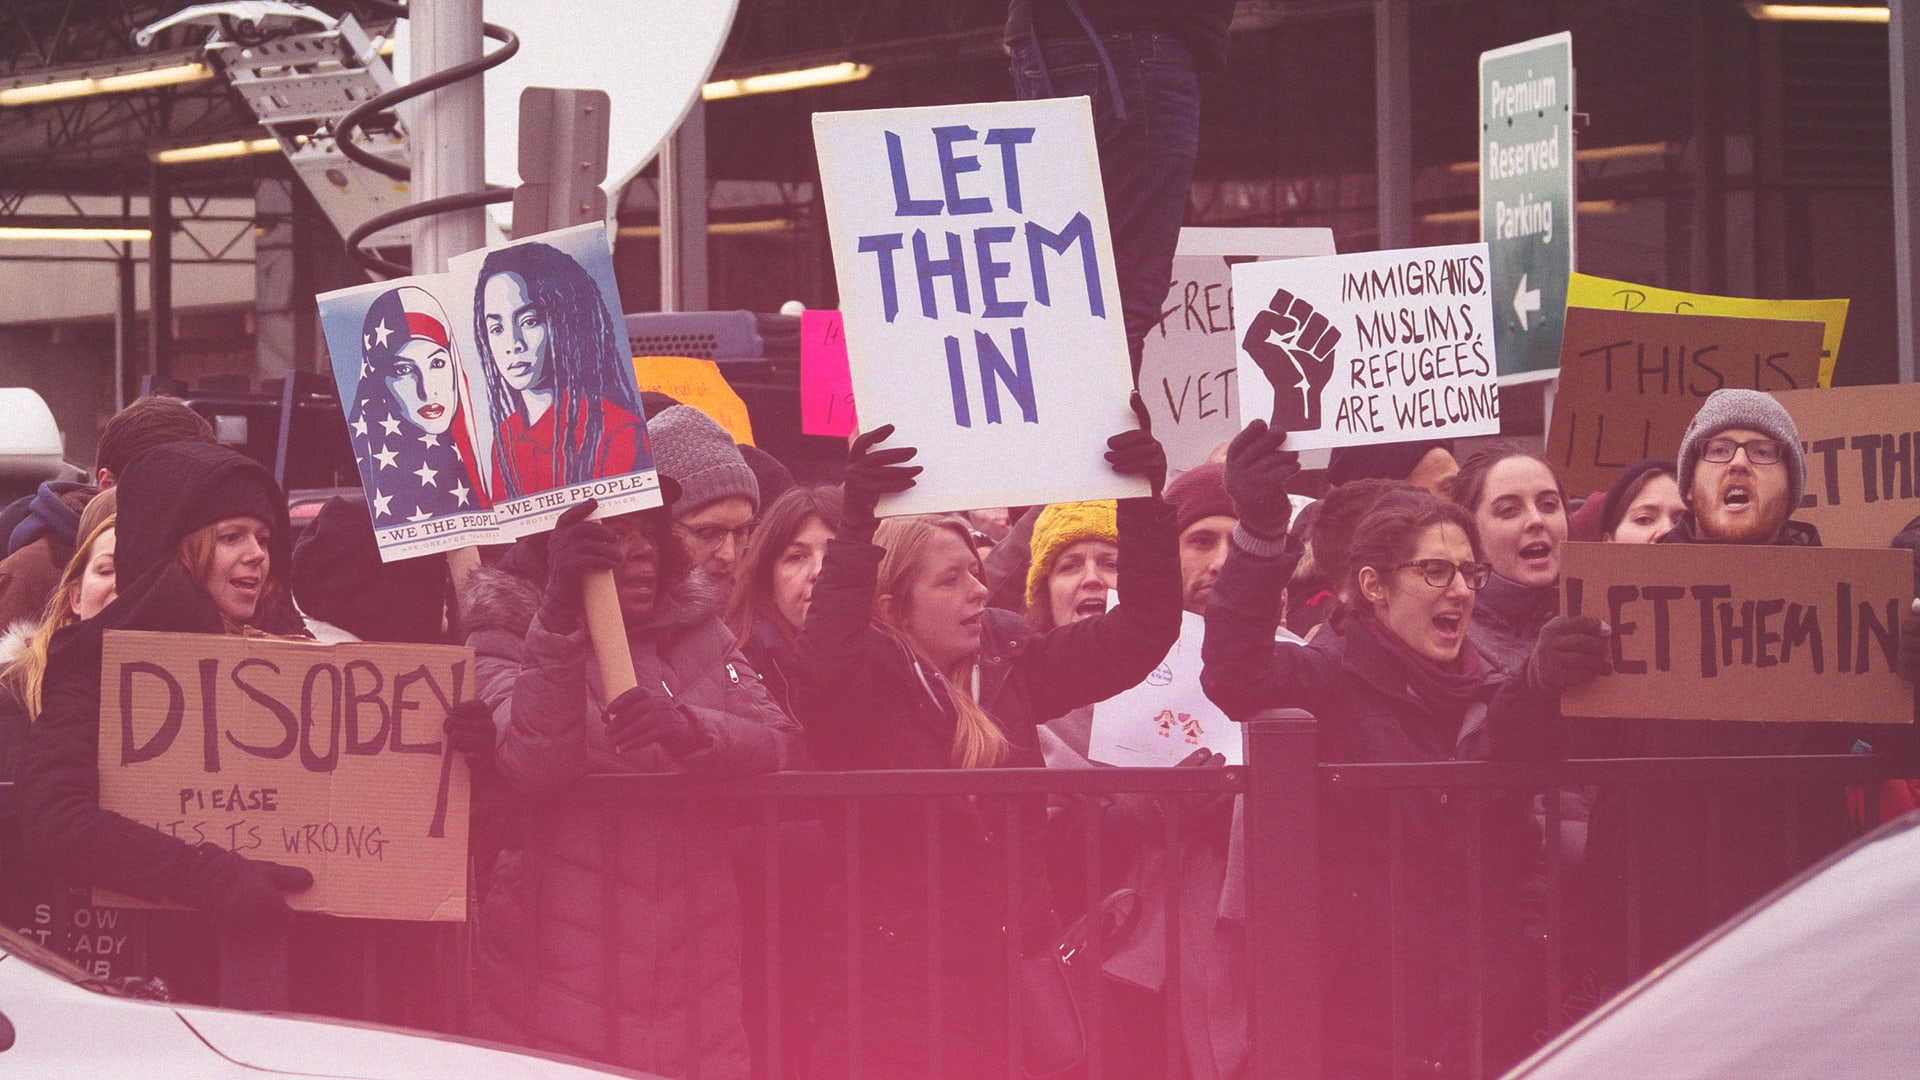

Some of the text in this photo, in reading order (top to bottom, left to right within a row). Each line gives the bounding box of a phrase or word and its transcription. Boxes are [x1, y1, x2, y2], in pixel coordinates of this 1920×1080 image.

[1491, 69, 1556, 118] Premium
[885, 125, 1036, 216] LET
[1489, 124, 1559, 180] Reserved
[1496, 193, 1552, 243] Parking
[858, 211, 1105, 323] THEM
[1355, 303, 1482, 352] MUSLIMS,
[944, 327, 1038, 428] IN
[1350, 341, 1489, 389] REFUGEES
[1580, 340, 1798, 397] THIS IS
[1335, 382, 1500, 434] ARE WELCOME
[506, 476, 643, 515] WE THE PEOPLE
[389, 527, 418, 541] WE
[421, 519, 457, 535] THE
[1690, 584, 1825, 678] THEM
[1837, 582, 1900, 675] IN
[120, 658, 466, 838] DISOBEY
[226, 820, 262, 852] IS
[282, 822, 389, 861] WRONG
[35, 904, 119, 929] SOW
